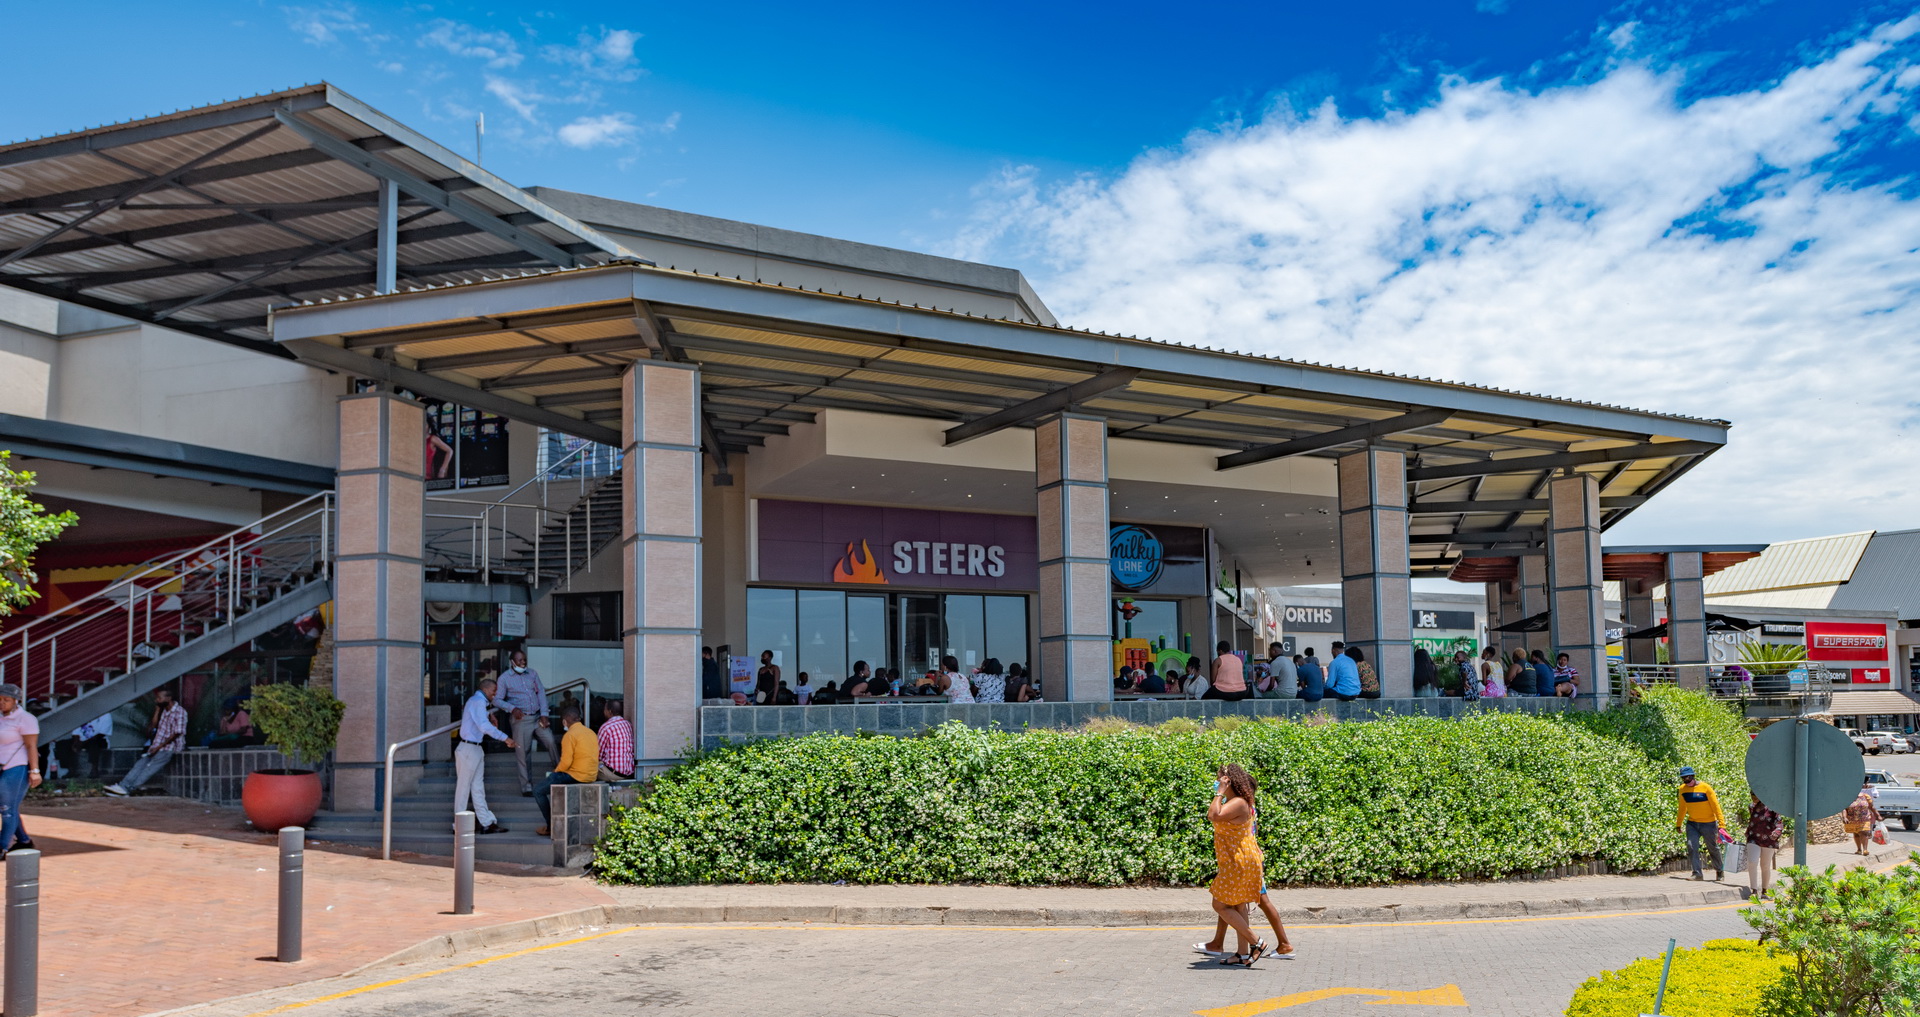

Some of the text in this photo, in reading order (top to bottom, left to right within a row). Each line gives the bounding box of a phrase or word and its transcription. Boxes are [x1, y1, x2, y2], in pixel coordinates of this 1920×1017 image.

[893, 540, 1005, 578] STEERS
[1111, 534, 1161, 573] milky
[1118, 560, 1143, 573] LANE
[1285, 606, 1333, 624] ORTHS
[1417, 610, 1438, 628] Jet
[1282, 641, 1291, 652] G
[1411, 639, 1472, 655] ERMANS
[1823, 637, 1877, 646] SUPERSPAR
